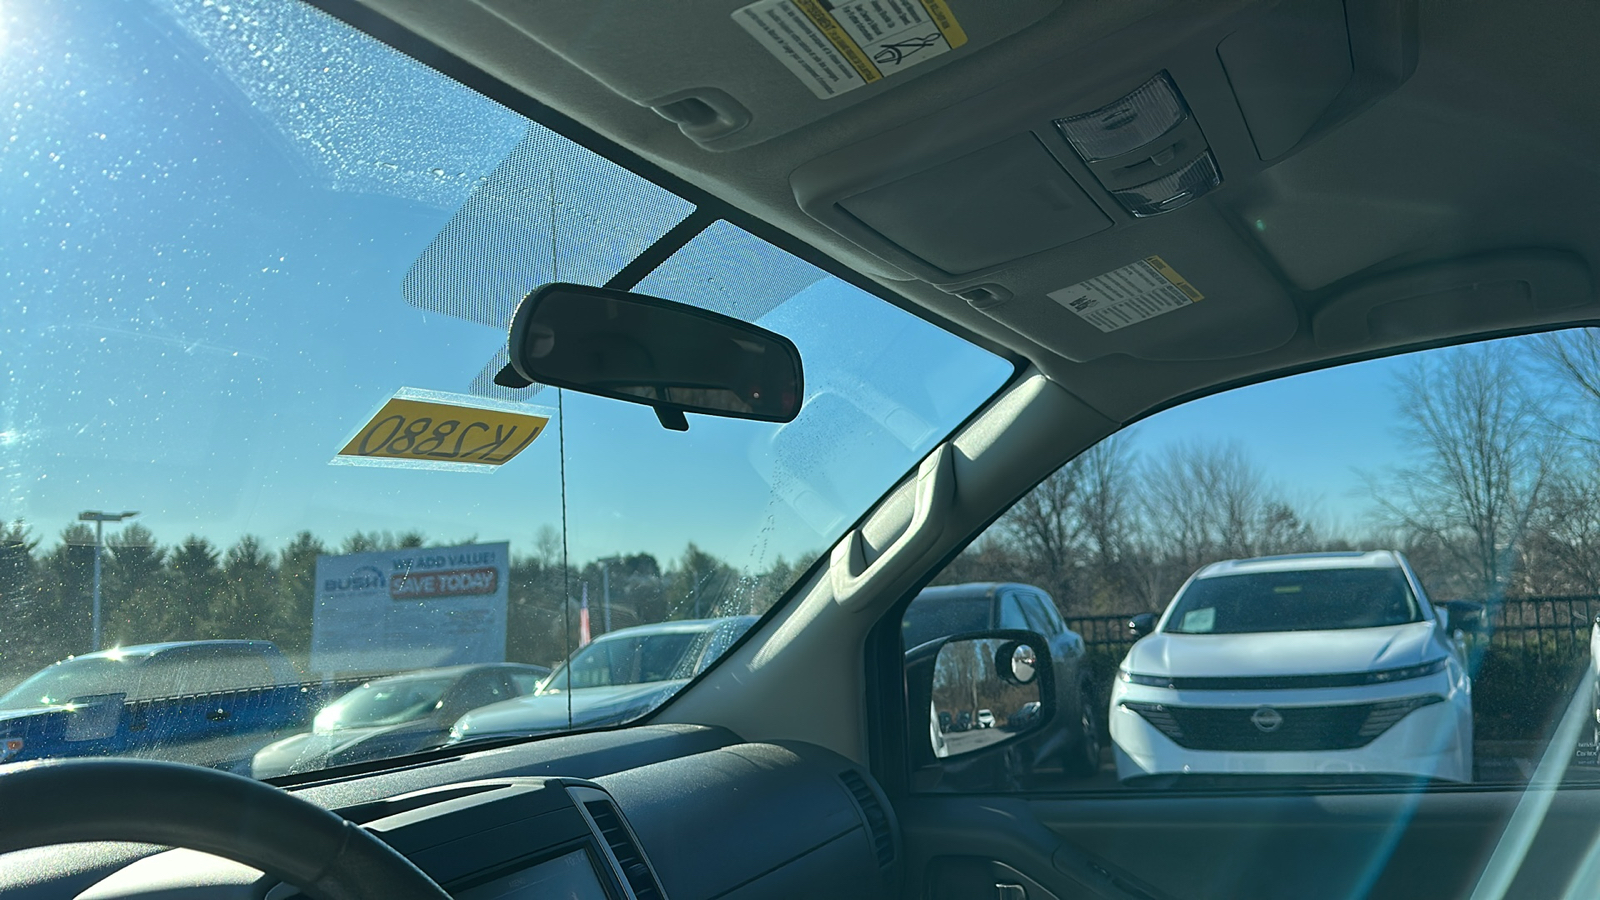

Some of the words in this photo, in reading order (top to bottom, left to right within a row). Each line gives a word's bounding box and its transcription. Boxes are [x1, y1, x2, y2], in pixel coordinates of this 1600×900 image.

[417, 556, 446, 568] ADD
[450, 552, 496, 566] VALUE!
[392, 576, 436, 594] SAVE
[439, 572, 493, 591] TODAY
